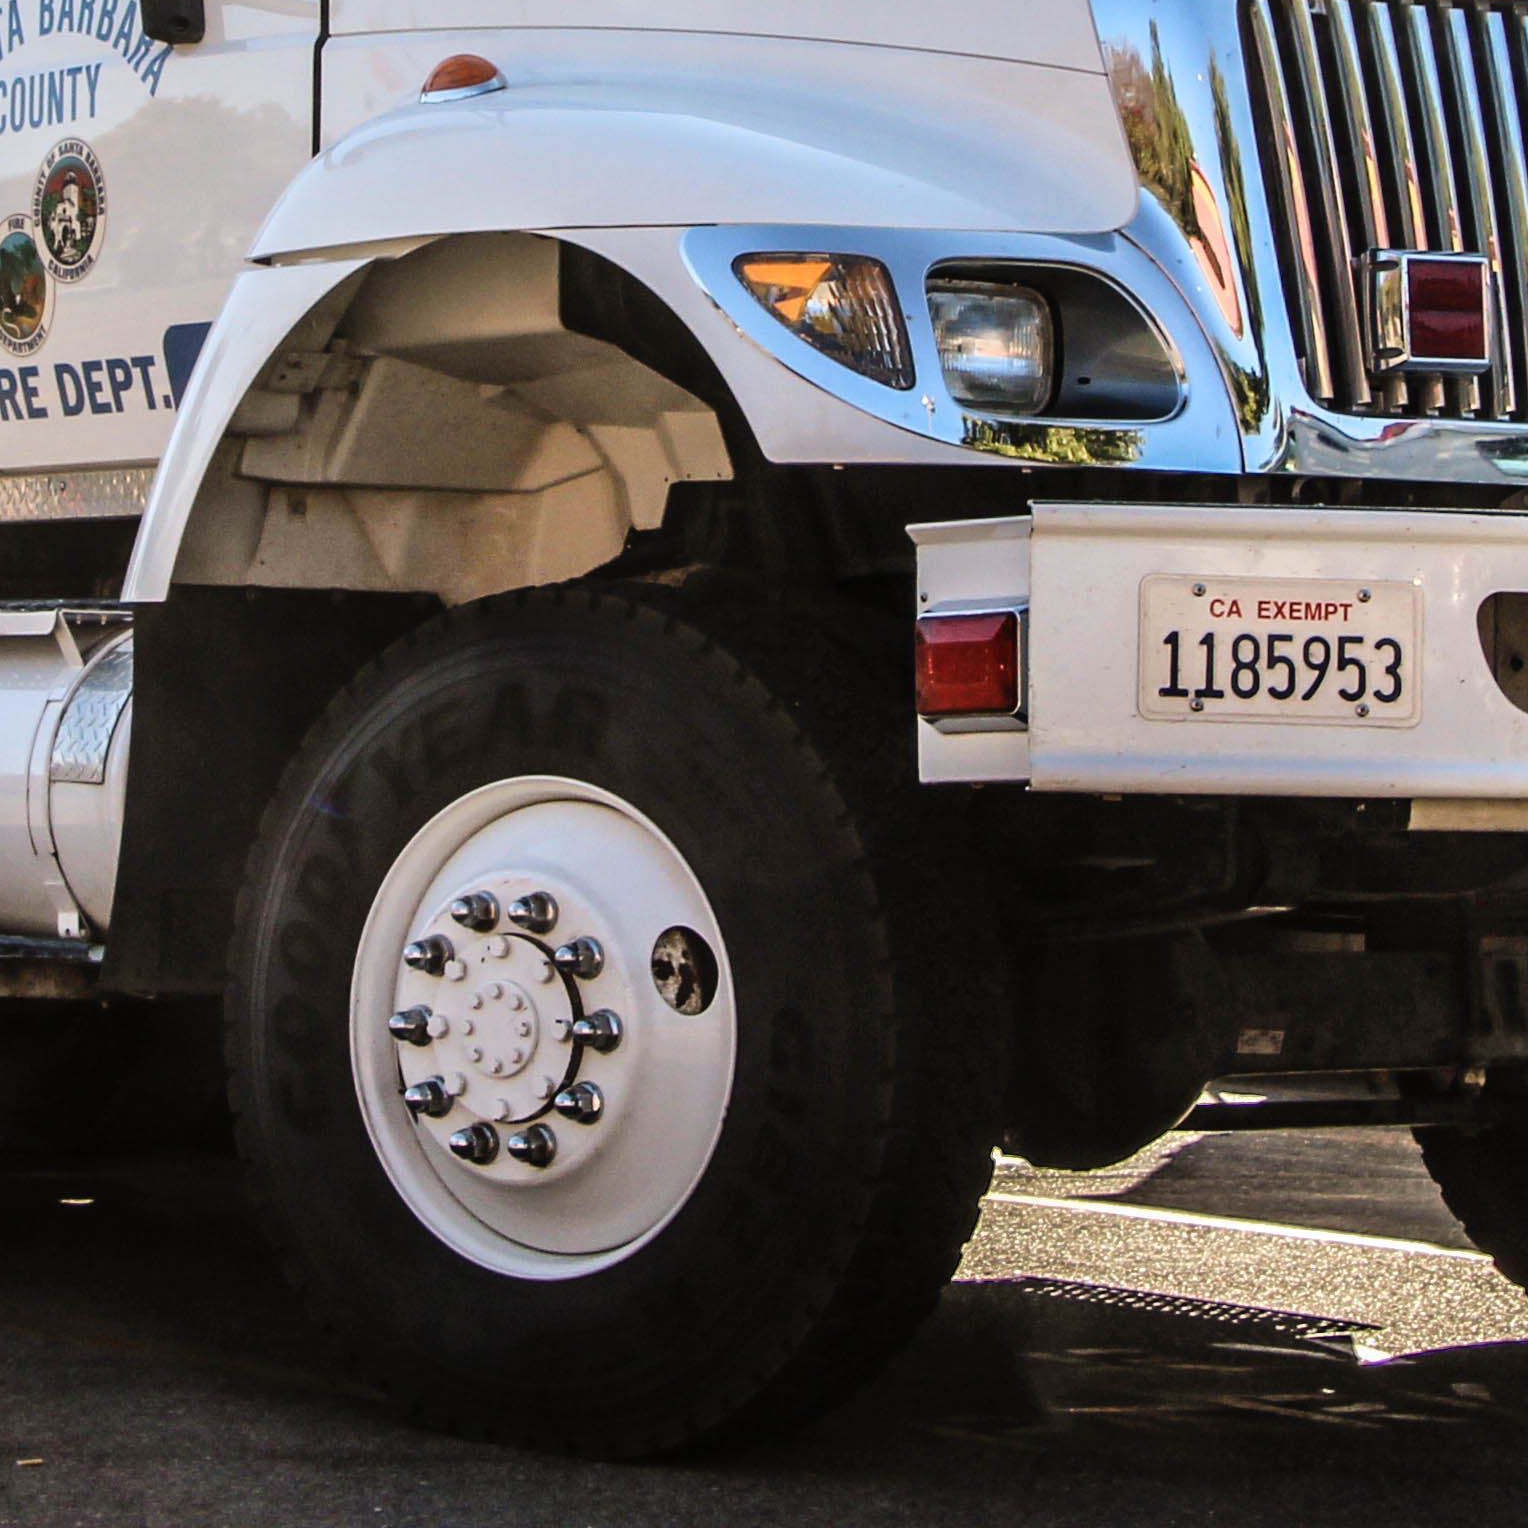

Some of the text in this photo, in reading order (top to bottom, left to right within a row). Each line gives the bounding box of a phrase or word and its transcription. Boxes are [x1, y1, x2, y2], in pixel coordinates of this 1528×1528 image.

[56, 354, 174, 417] DEPT.
[1209, 599, 1353, 622] CA EXEMPT
[1158, 630, 1403, 704] 1185953
